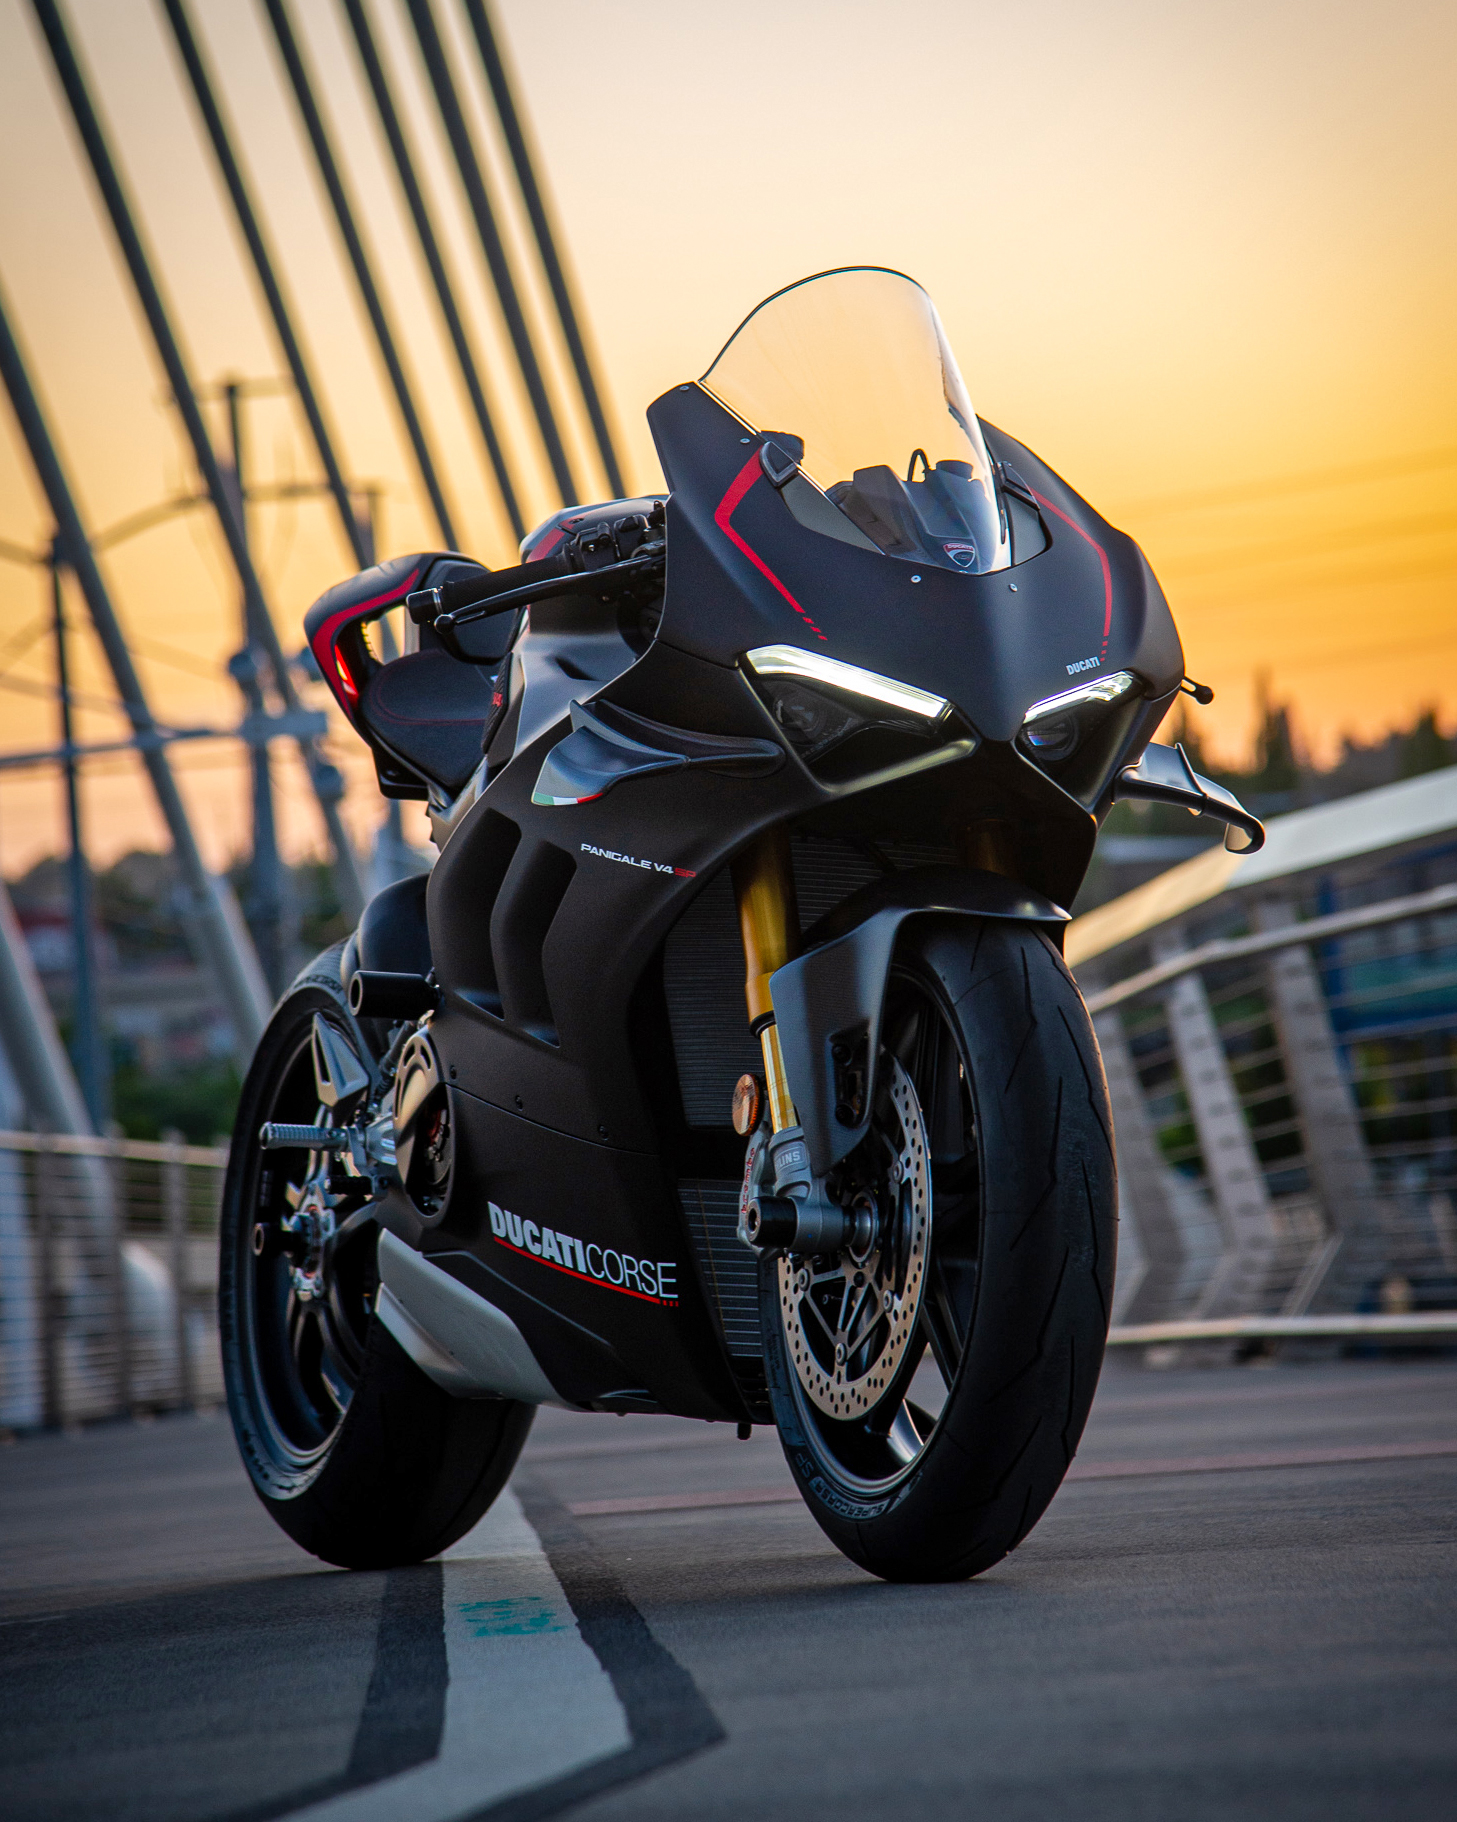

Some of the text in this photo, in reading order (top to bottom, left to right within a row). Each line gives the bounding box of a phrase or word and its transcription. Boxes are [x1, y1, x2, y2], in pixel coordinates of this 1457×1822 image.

[1066, 656, 1100, 675] DUCATI
[581, 843, 652, 869] PANIGALE
[813, 1482, 885, 1518] SUPERCORSA
